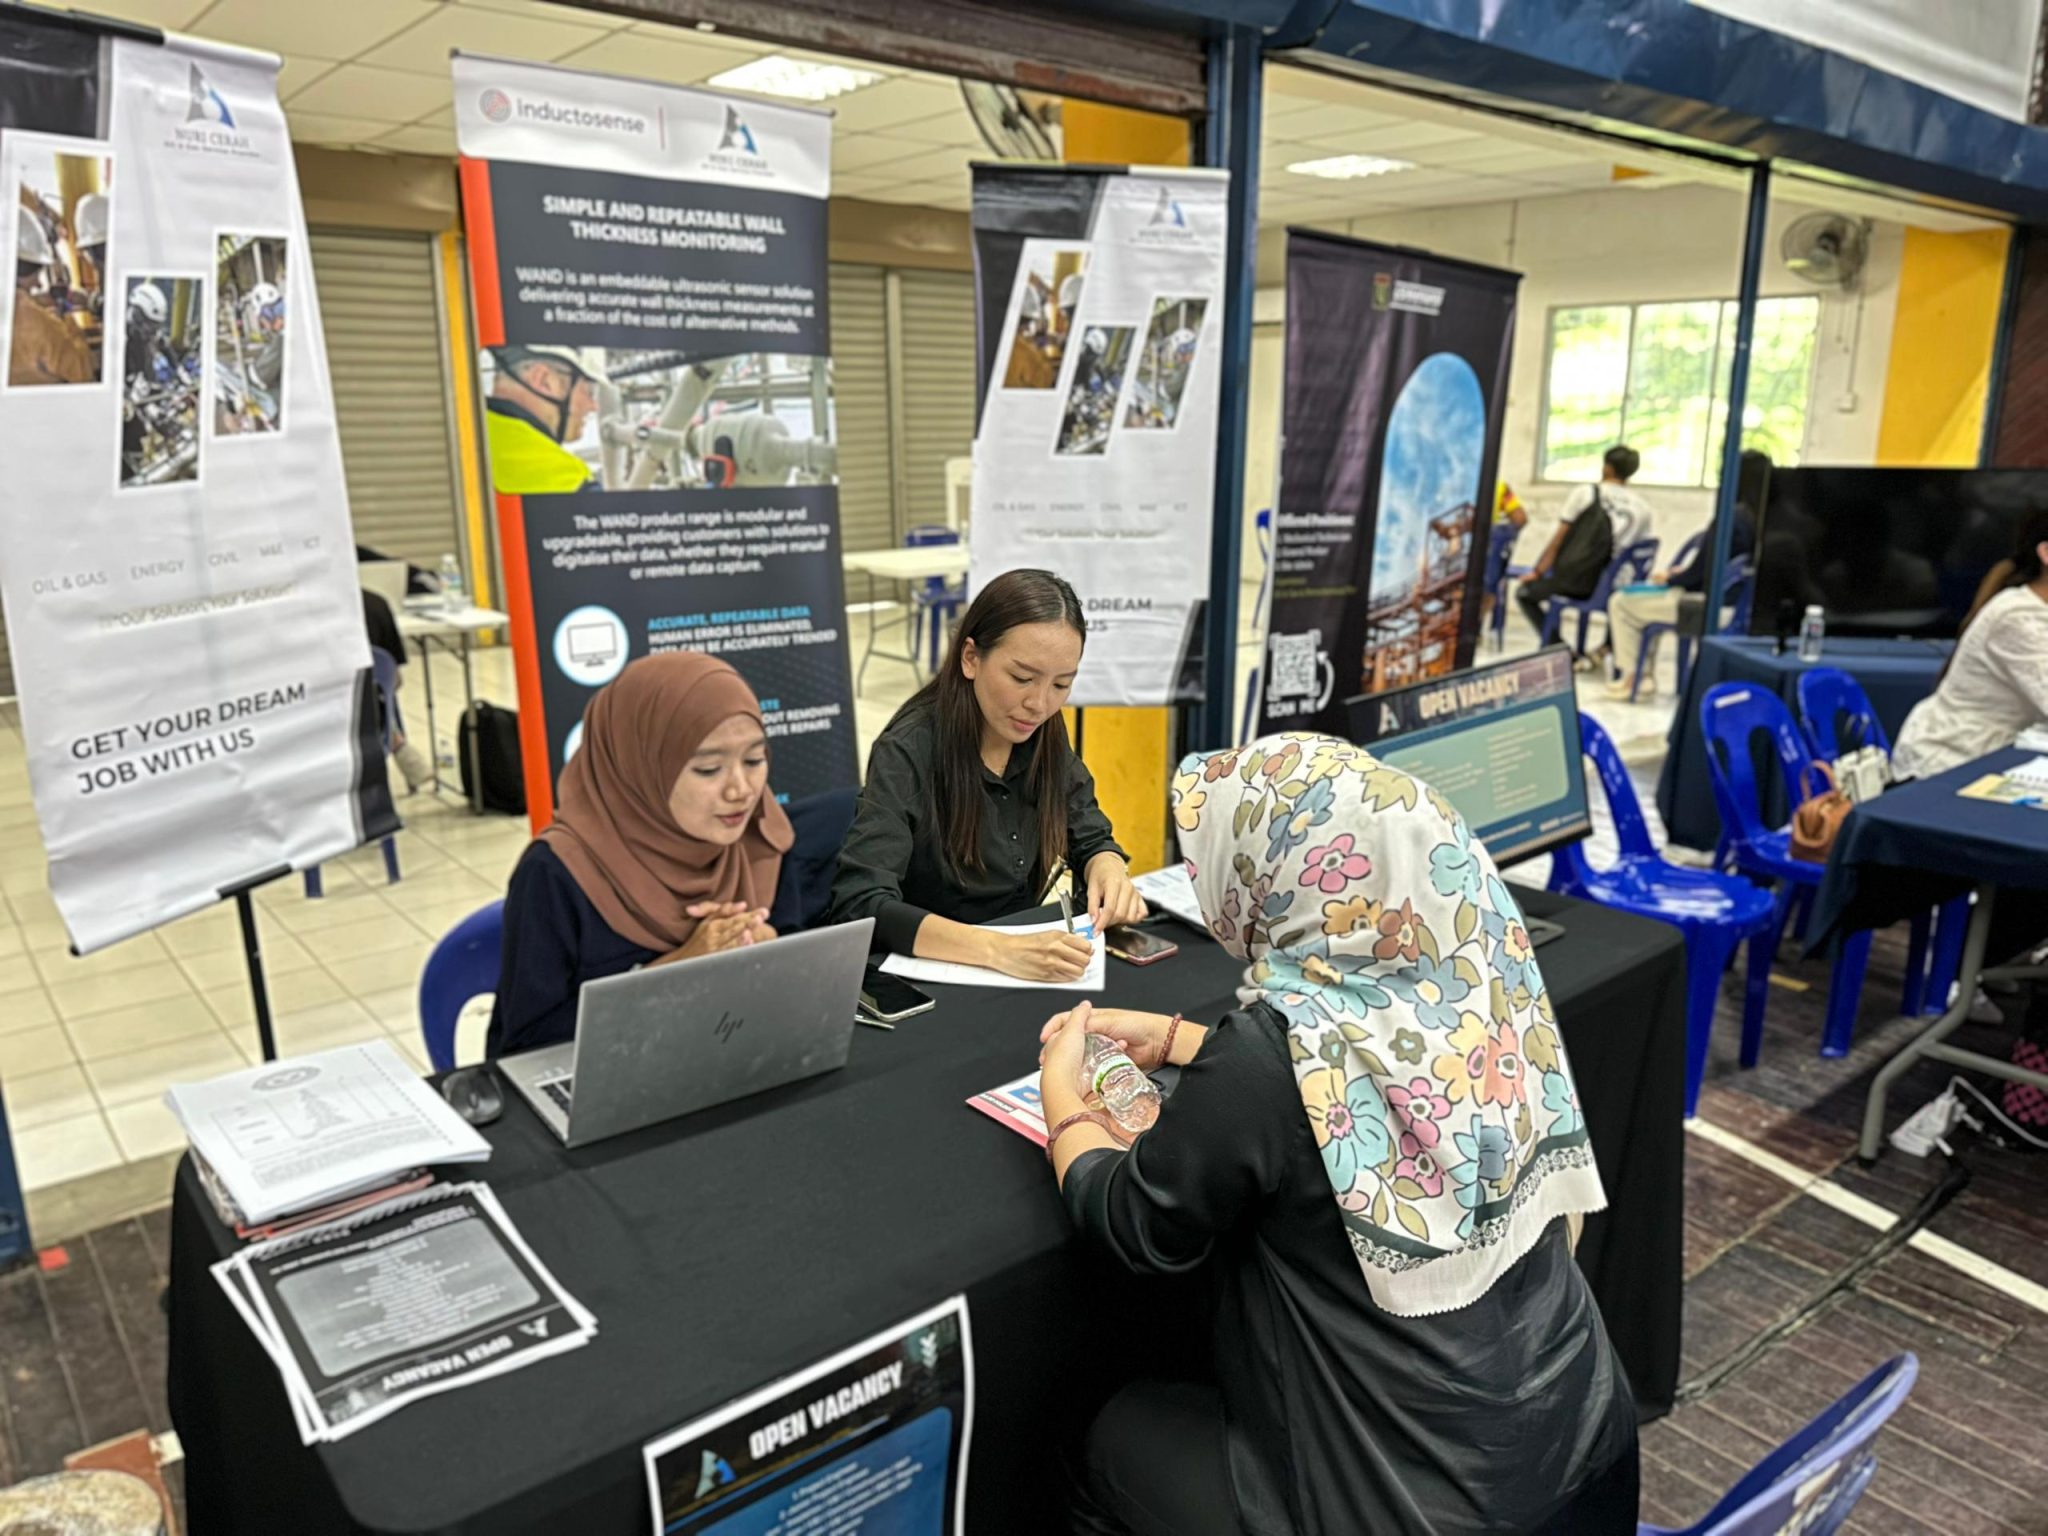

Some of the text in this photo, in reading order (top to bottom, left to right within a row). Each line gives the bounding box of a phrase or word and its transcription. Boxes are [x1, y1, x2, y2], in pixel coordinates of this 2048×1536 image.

[543, 194, 787, 235] SIMPLE AND REPEATABLE WALL
[569, 220, 767, 254] THICKNESS MONITORING
[515, 266, 815, 300] WAND is an embeddable ultrasonic sensor solution
[518, 285, 587, 308] delivering
[588, 292, 639, 308] accurate
[664, 295, 721, 312] thickness
[722, 299, 803, 317] measurements
[543, 309, 554, 322] a
[555, 306, 606, 324] fraction
[607, 308, 622, 325] of
[622, 310, 641, 327] the
[642, 313, 668, 329] cost
[668, 312, 684, 329] of
[684, 313, 749, 331] alternative
[573, 506, 807, 531] The WAND product range is modular and
[626, 528, 681, 549] providing
[682, 528, 743, 542] customers
[743, 524, 770, 539] with
[771, 523, 819, 538] solutions
[208, 551, 240, 568] CIVIL
[552, 550, 610, 571] digitalise
[611, 548, 638, 564] their
[670, 544, 717, 559] whether
[718, 542, 745, 559] they
[746, 541, 788, 557] require
[789, 538, 827, 552] manual
[130, 559, 185, 581] ENERGY
[629, 567, 643, 580] or
[644, 563, 686, 578] remote
[687, 560, 715, 576] data
[32, 571, 108, 595] OIL & GAS
[1087, 597, 1152, 612] DREAM
[648, 605, 811, 630] ACCURATE, REPEATABLE DATA
[648, 629, 693, 645] HUMAN
[694, 624, 731, 640] ERROR
[732, 623, 744, 636] IS
[707, 640, 721, 653] BE
[722, 634, 790, 652] ACCURATELY
[792, 629, 838, 645] TRENDED
[1419, 669, 1520, 720] OPEN VACANCY
[785, 702, 841, 722] REMOVING
[1267, 698, 1316, 718] SCAN ME
[71, 682, 305, 760] GET YOUR DREAM
[789, 718, 832, 734] REPAIRS
[77, 727, 255, 794] JOB WITH US
[713, 1011, 744, 1045] hp
[382, 1335, 514, 1392] OPEN VACANCY
[748, 1359, 904, 1460] OPEN VACANCY
